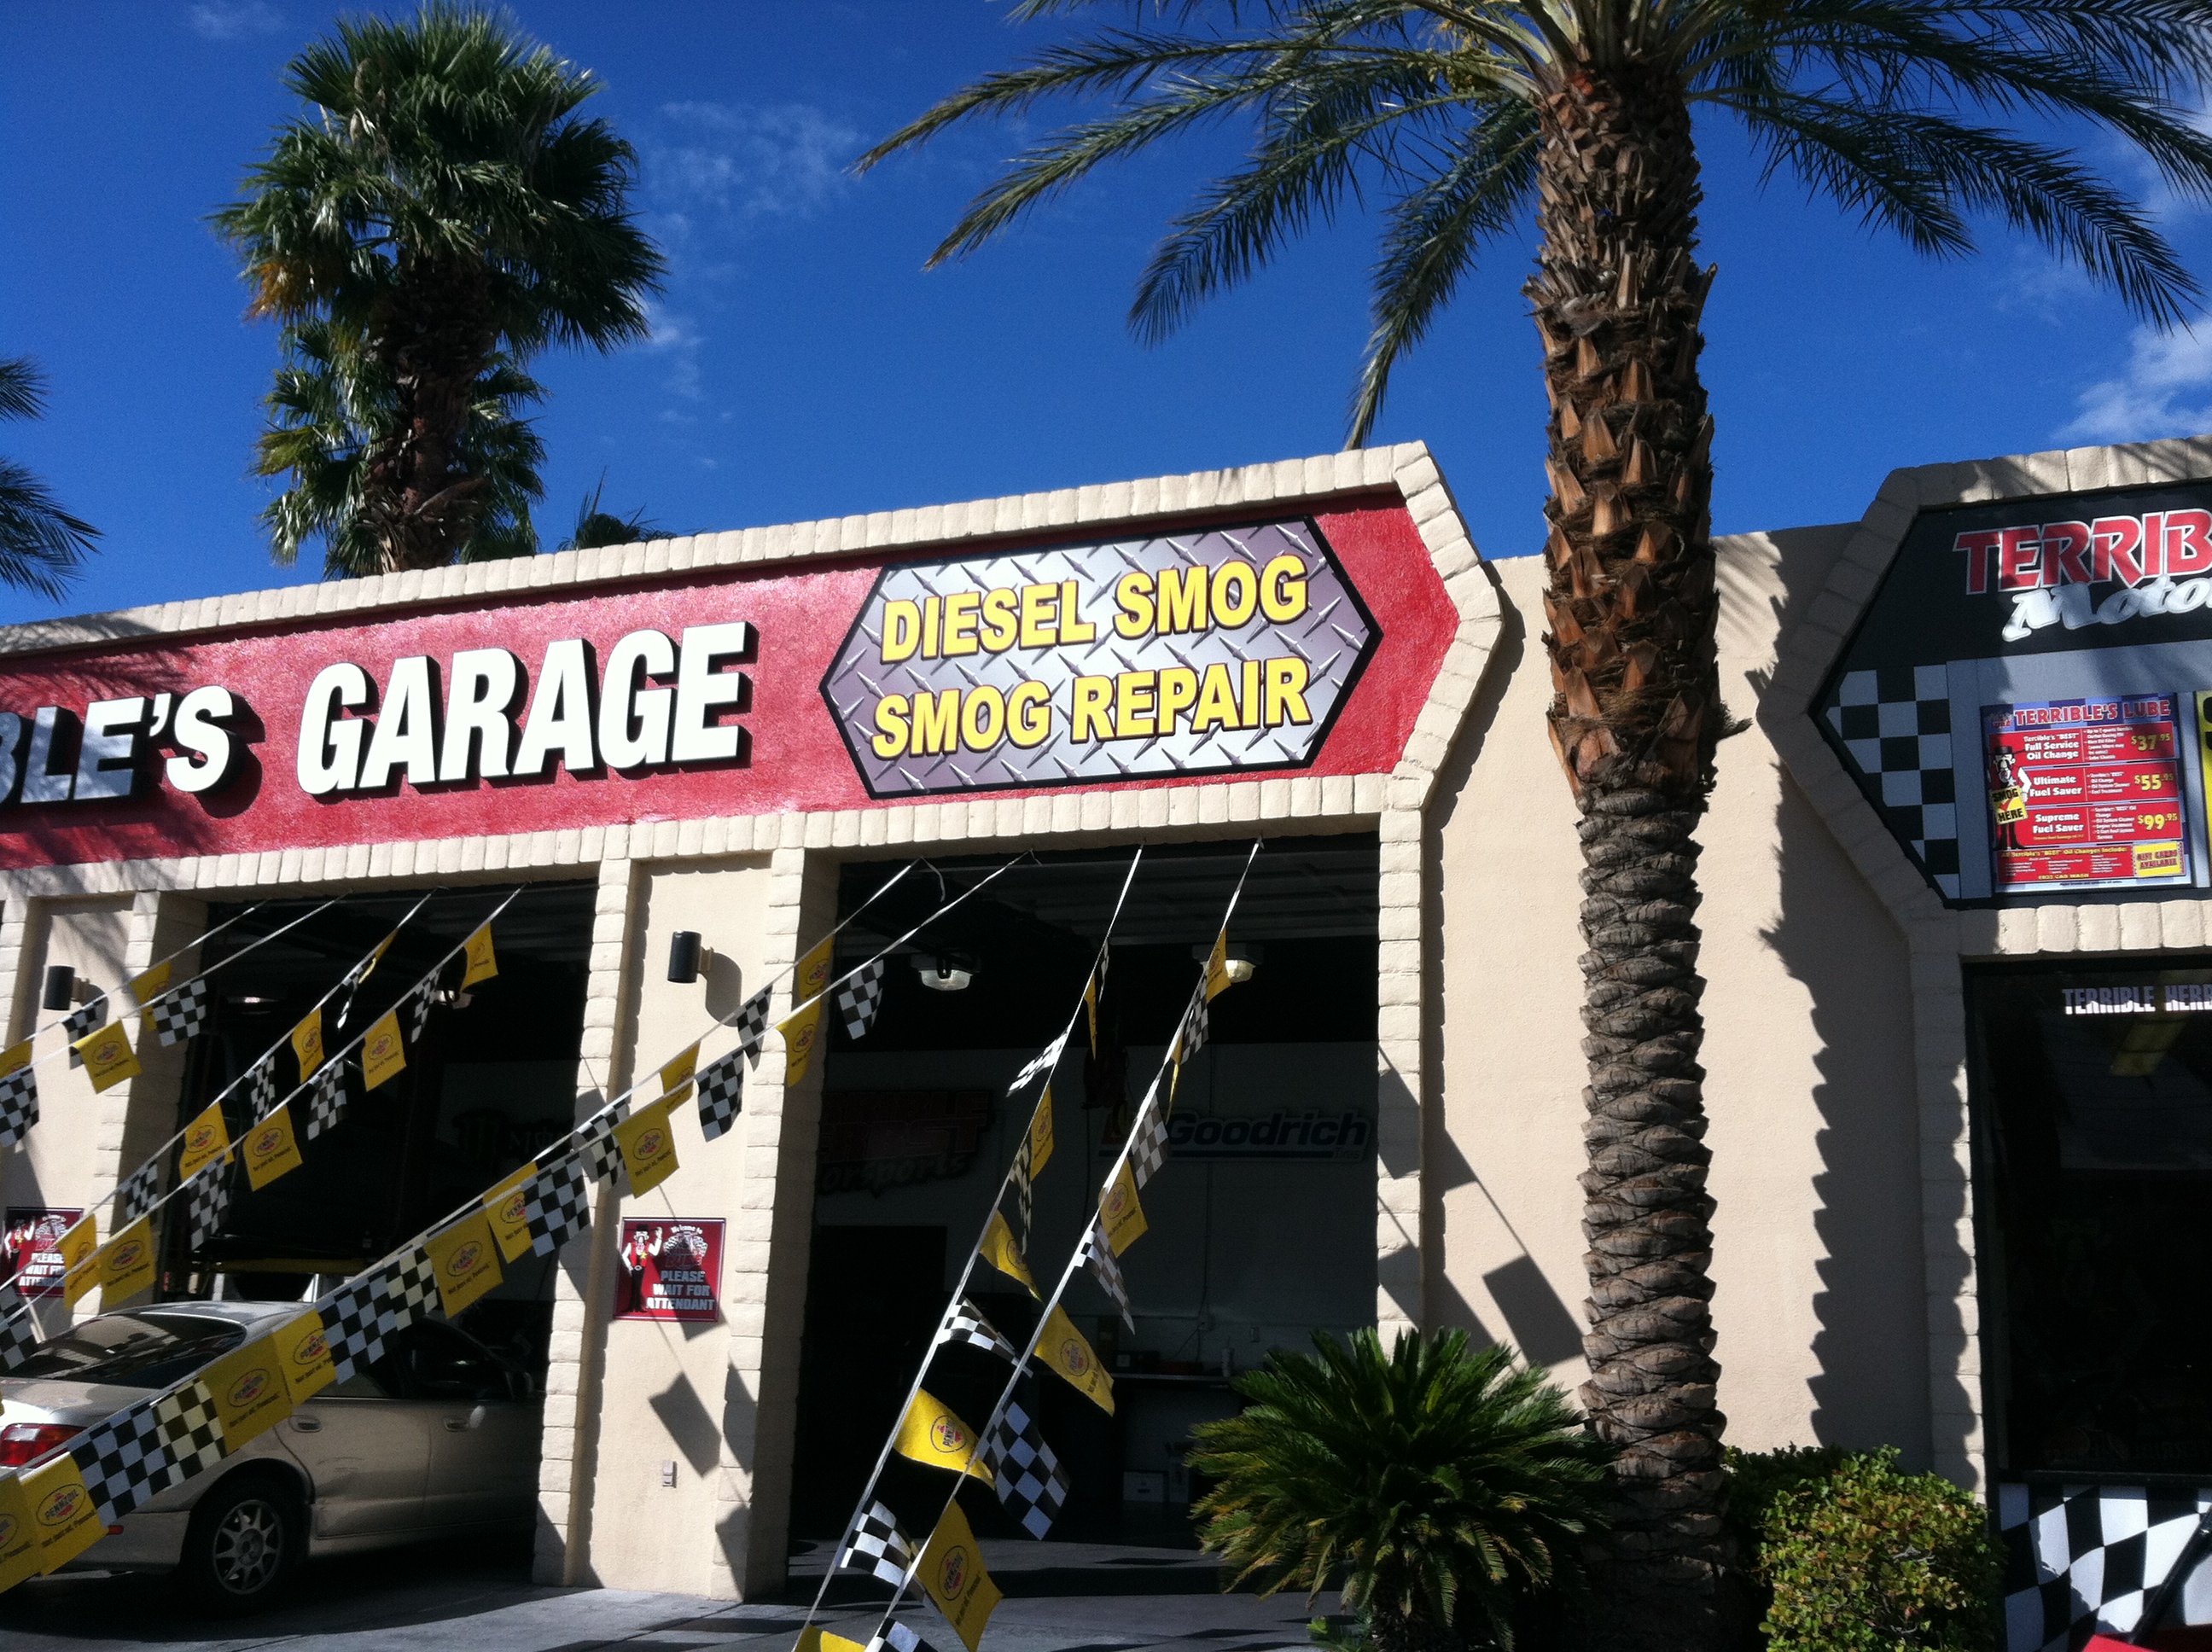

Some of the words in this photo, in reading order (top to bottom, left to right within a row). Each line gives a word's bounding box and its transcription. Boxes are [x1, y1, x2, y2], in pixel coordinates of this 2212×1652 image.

[881, 580, 1096, 663] DIESEL
[1114, 555, 1308, 639] SMOG
[2002, 574, 2212, 643] Moto
[296, 621, 748, 795] GARAGE
[871, 679, 1052, 760] SMOG
[1069, 659, 1313, 743] REPAIR
[2014, 703, 2117, 725] TERRIBLE'S
[2122, 700, 2170, 718] LUBE
[2024, 742, 2041, 751] Full
[2044, 741, 2079, 749] Service
[2026, 752, 2041, 760] Oil
[2043, 750, 2079, 759] Change
[2033, 776, 2076, 785] Ultimate
[1992, 788, 2019, 802] SMOG
[2029, 788, 2051, 797] Fuel
[2052, 787, 2082, 796] Saver
[1998, 808, 2024, 822] HERE
[2034, 813, 2080, 823] Supreme
[2138, 812, 2178, 831] $99.95
[2033, 824, 2053, 834] Fuel
[2055, 823, 2084, 833] Saver
[2062, 986, 2156, 1015] TERRIBLE
[1167, 1112, 1368, 1145] Goodrich
[25, 1265, 49, 1275] WAIT
[661, 1271, 705, 1282] PLEASE
[653, 1283, 685, 1296] WAIT
[686, 1284, 711, 1296] FOR
[646, 1297, 715, 1311] ATTENDANT
[44, 1488, 80, 1521] PENNZOIL
